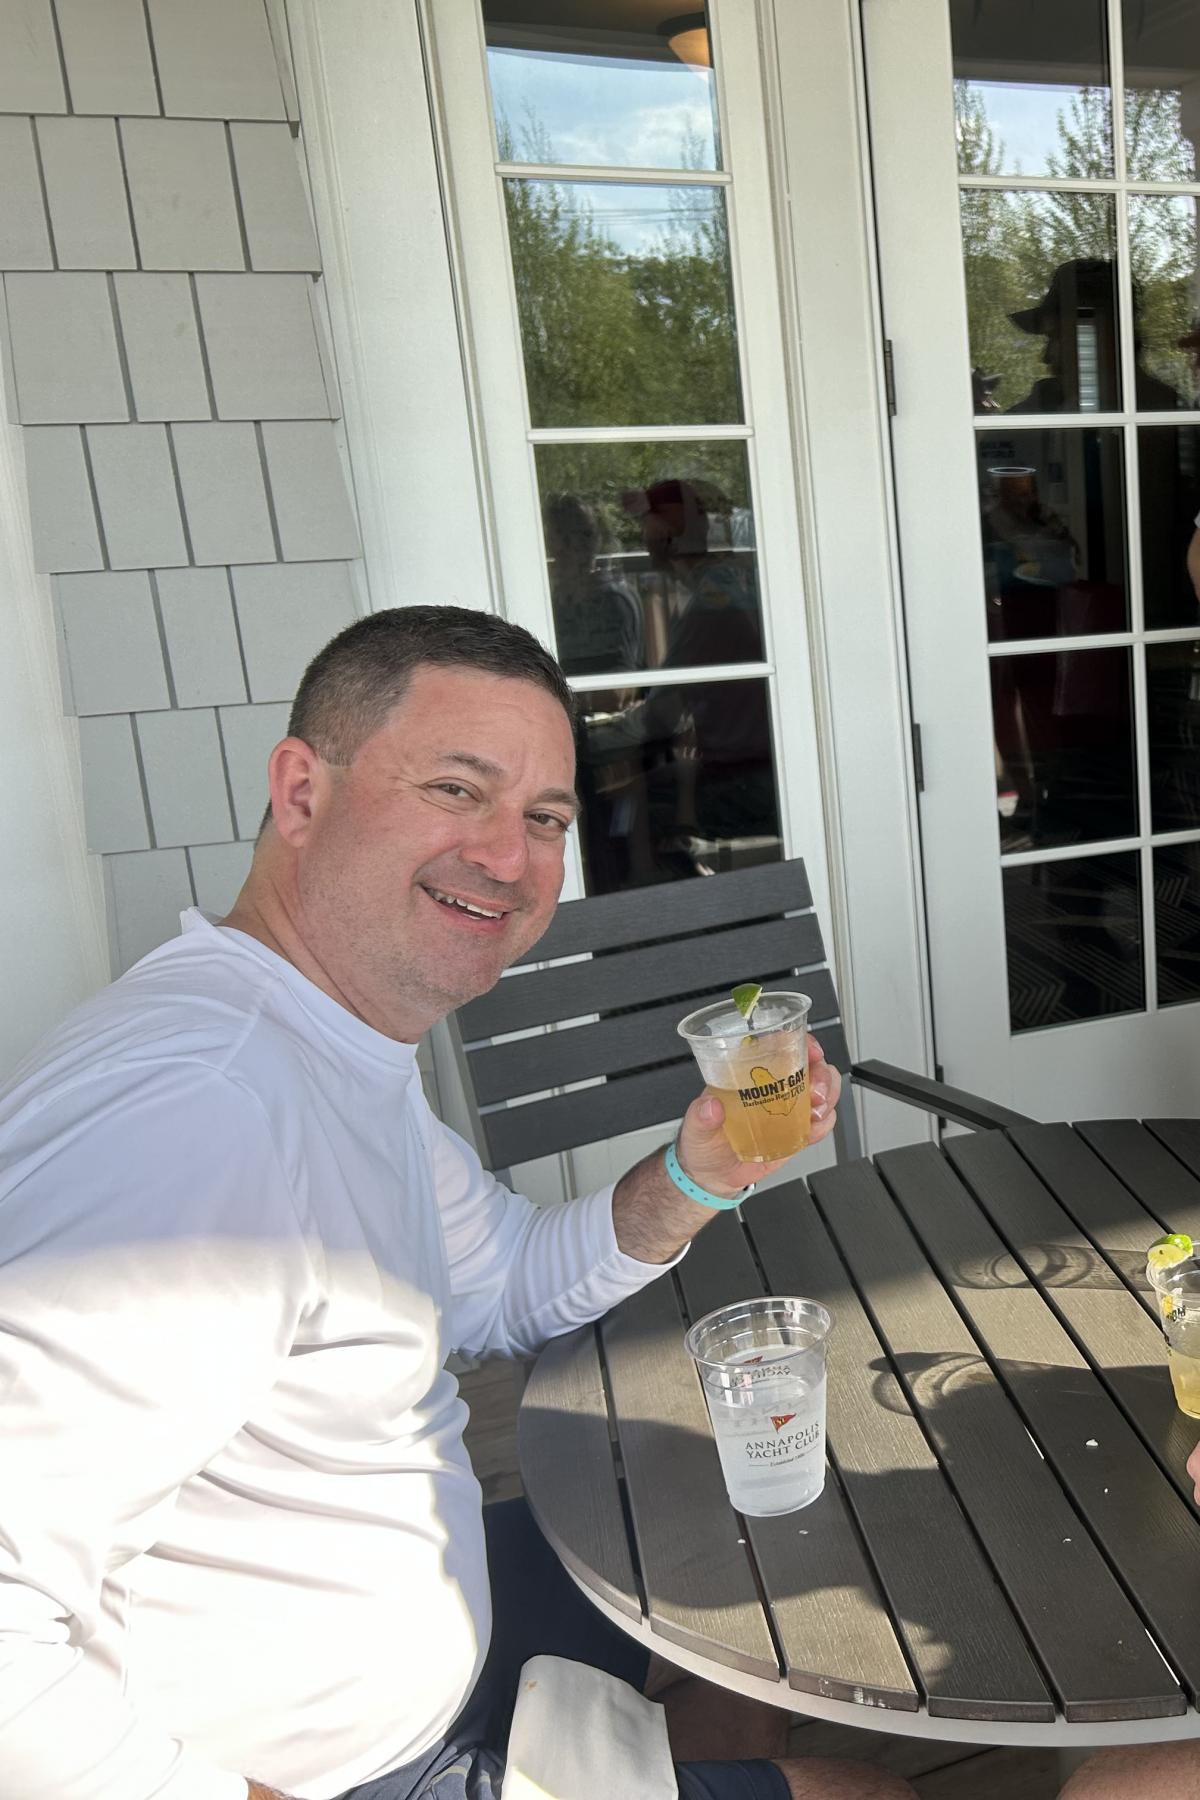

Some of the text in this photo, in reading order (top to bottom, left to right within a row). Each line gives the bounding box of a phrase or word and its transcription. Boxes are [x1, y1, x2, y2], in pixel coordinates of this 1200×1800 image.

[738, 1078, 786, 1101] MOUNT
[745, 1422, 820, 1450] ANNAPOLIS
[746, 1430, 820, 1459] YACHT CLUB
